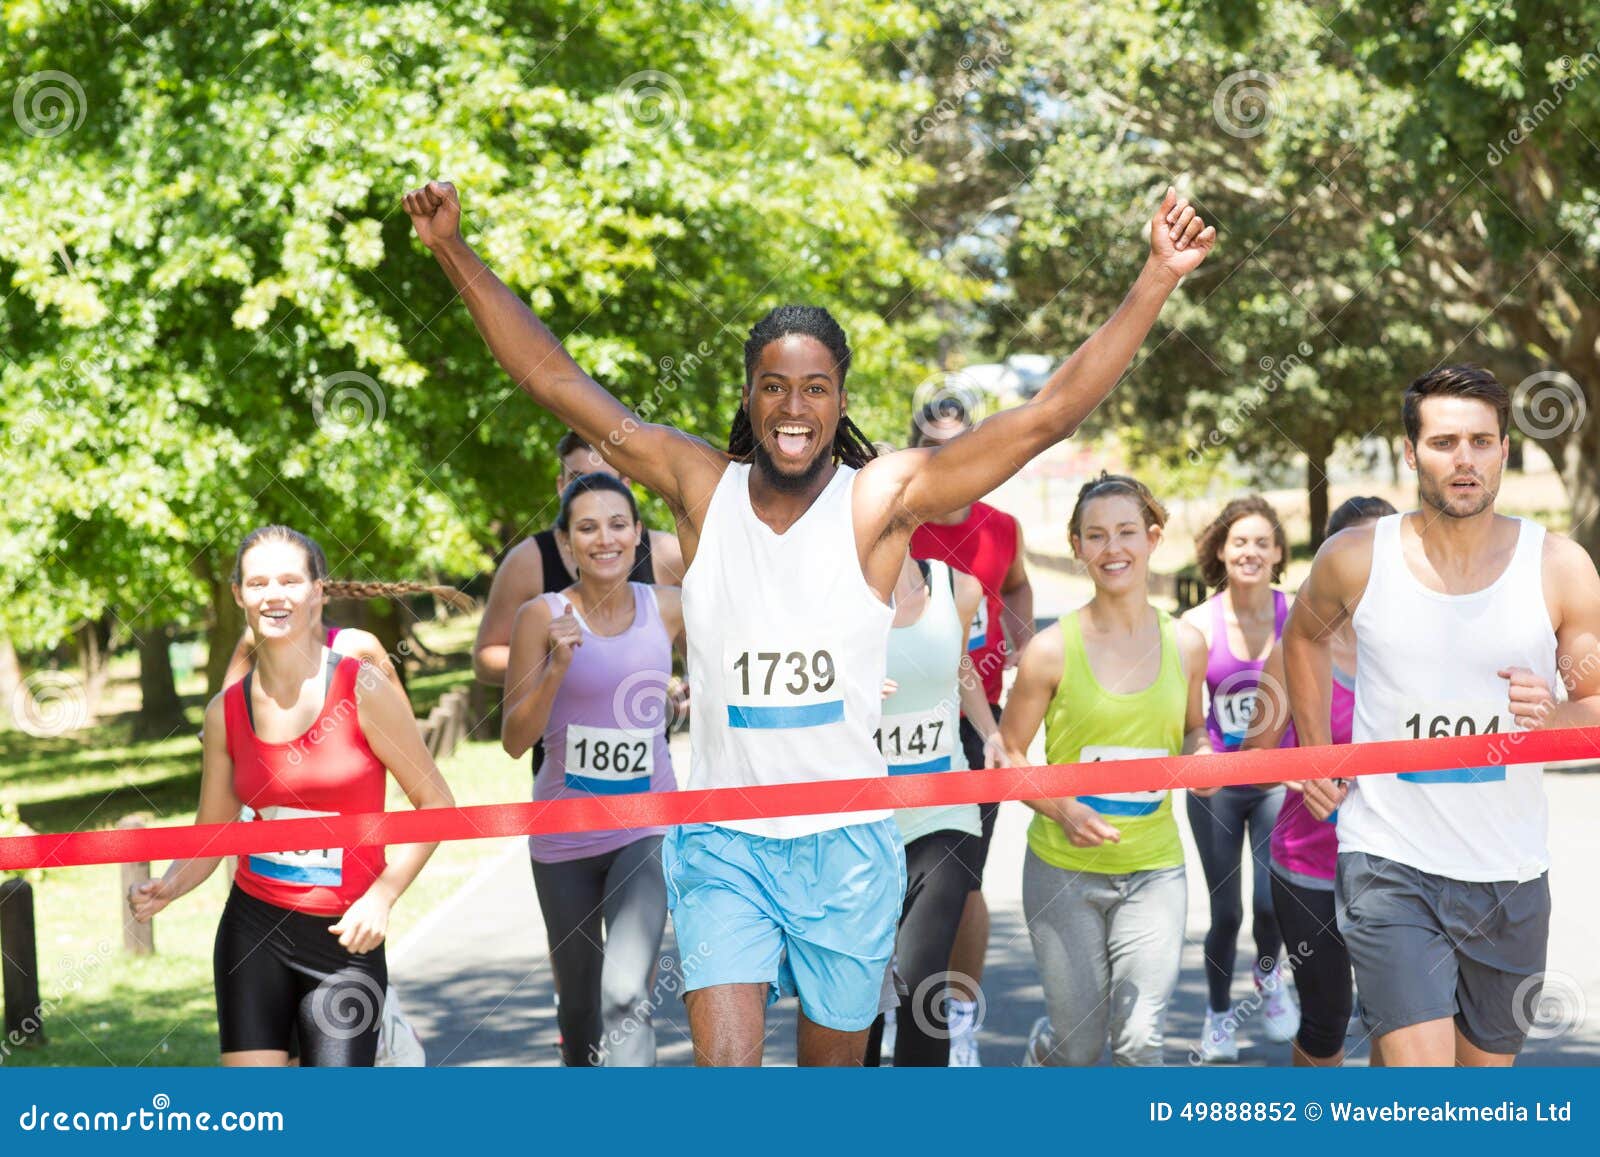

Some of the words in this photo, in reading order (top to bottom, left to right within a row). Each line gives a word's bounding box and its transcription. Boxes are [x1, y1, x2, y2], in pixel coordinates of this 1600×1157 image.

[733, 649, 836, 696] 1739
[574, 738, 648, 773] 1862
[872, 720, 944, 757] 1147
